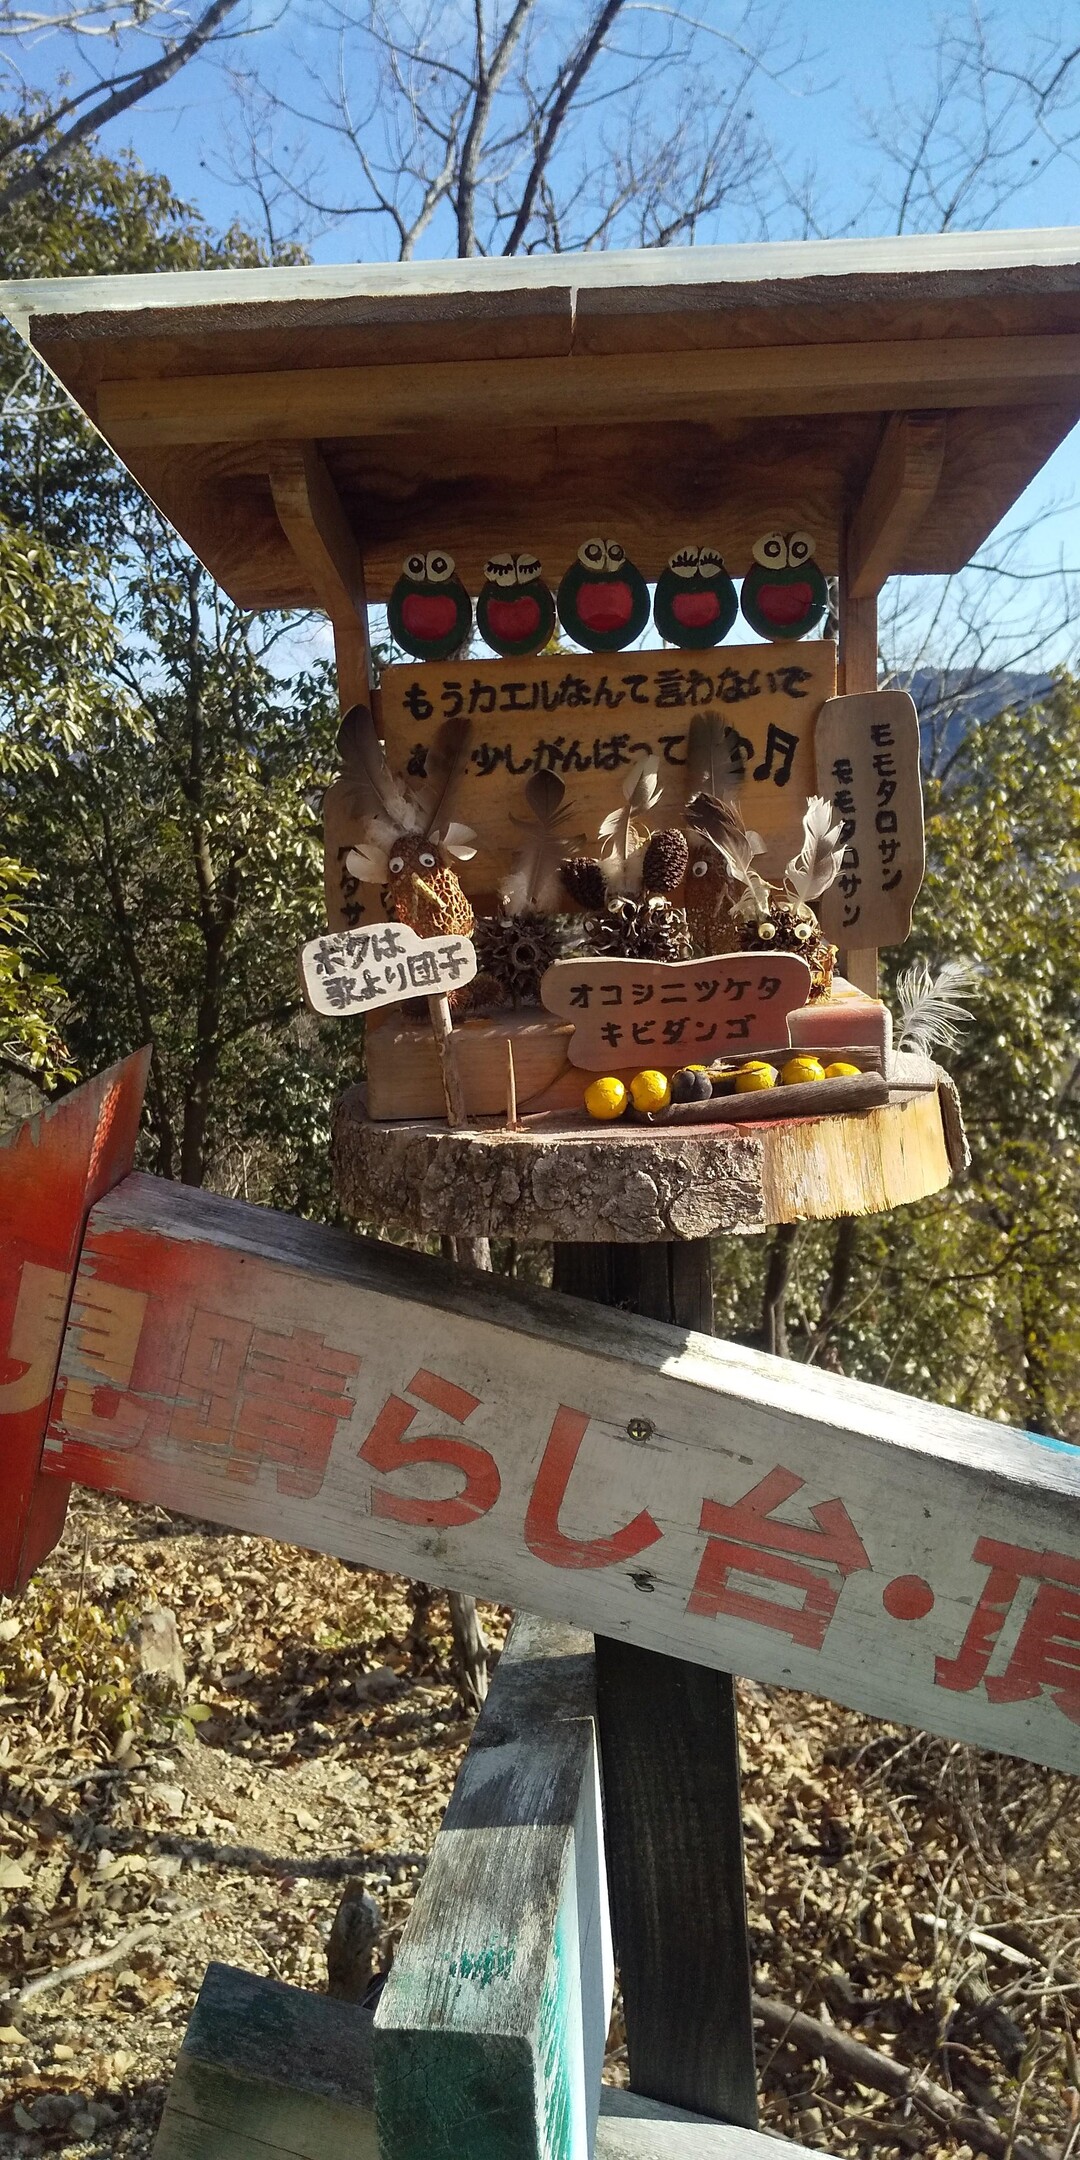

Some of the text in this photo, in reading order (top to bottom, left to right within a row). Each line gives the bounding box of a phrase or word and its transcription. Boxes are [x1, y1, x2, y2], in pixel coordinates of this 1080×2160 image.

[403, 665, 813, 720] もうカエルなんて言わないで
[870, 723, 902, 891] モモタロサン
[831, 758, 862, 927] モモタロサン
[322, 942, 469, 1009] 歌より団子
[569, 976, 782, 1008] オコシニツケタ
[600, 1013, 757, 1048] キビダンゴ
